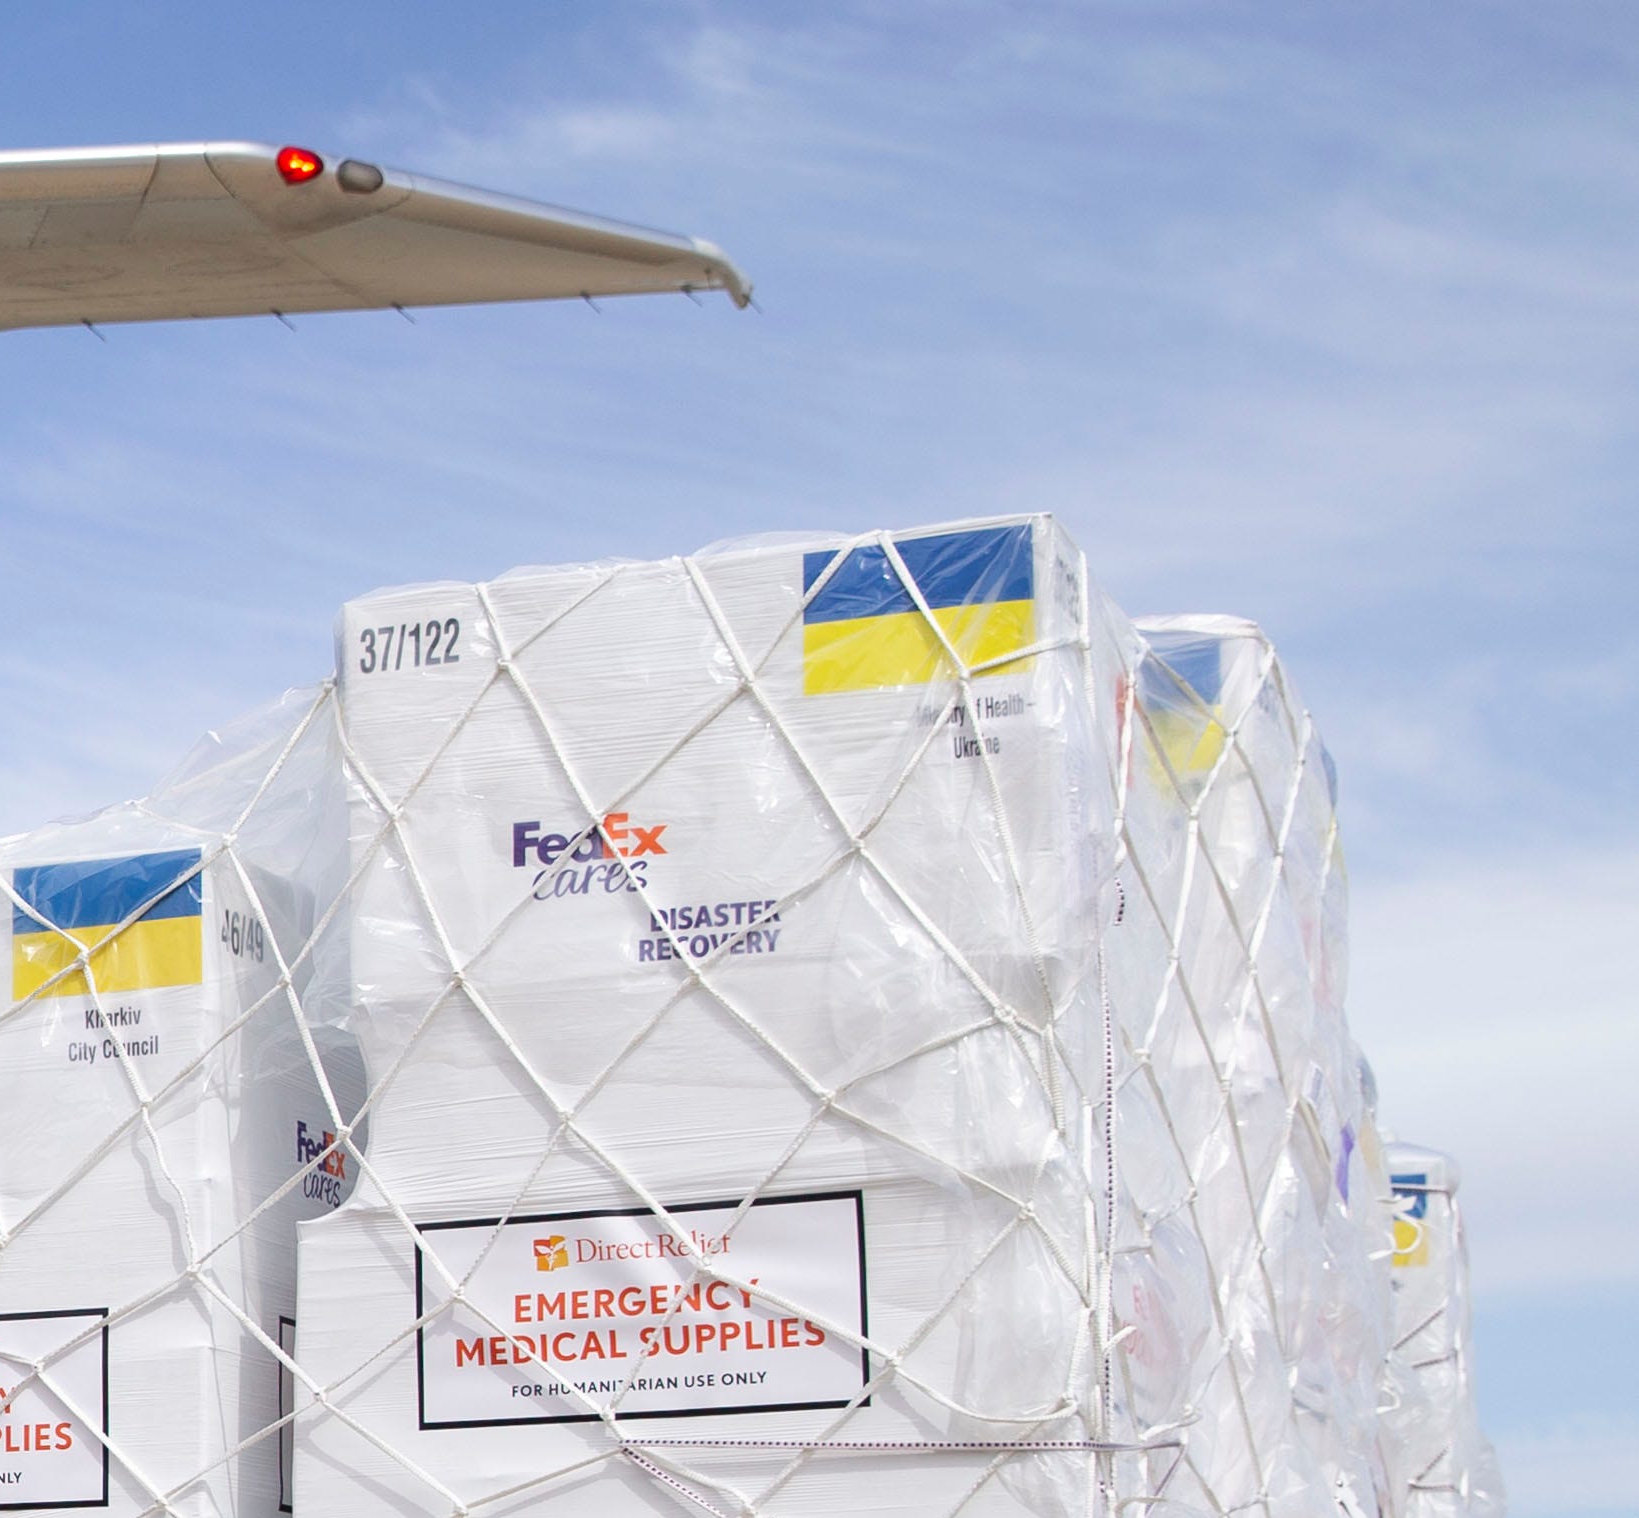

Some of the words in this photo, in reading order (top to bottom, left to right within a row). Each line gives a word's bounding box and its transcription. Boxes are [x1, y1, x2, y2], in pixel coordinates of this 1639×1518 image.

[359, 617, 461, 675] 37/122
[985, 693, 1024, 719] Health
[953, 734, 1000, 759] Ukrane
[512, 812, 668, 868] FedEx
[532, 860, 648, 900] cares
[649, 899, 782, 932] DISASTER
[221, 909, 264, 963] 46/49
[638, 929, 782, 962] RECOVERY
[85, 1006, 141, 1029] Kharkiv
[68, 1042, 96, 1064] City
[297, 1120, 346, 1180] FedEx
[304, 1172, 341, 1208] cares
[576, 1238, 654, 1263] Direct
[657, 1230, 731, 1258] Relief
[514, 1278, 759, 1323] EMERGENCY
[455, 1330, 627, 1368] MEDICAL
[640, 1318, 825, 1357] SUPPLIES
[512, 1384, 543, 1397] FOR
[548, 1376, 678, 1396] HUMANIARIAN
[685, 1374, 716, 1388] USE
[721, 1372, 767, 1387] ONLY
